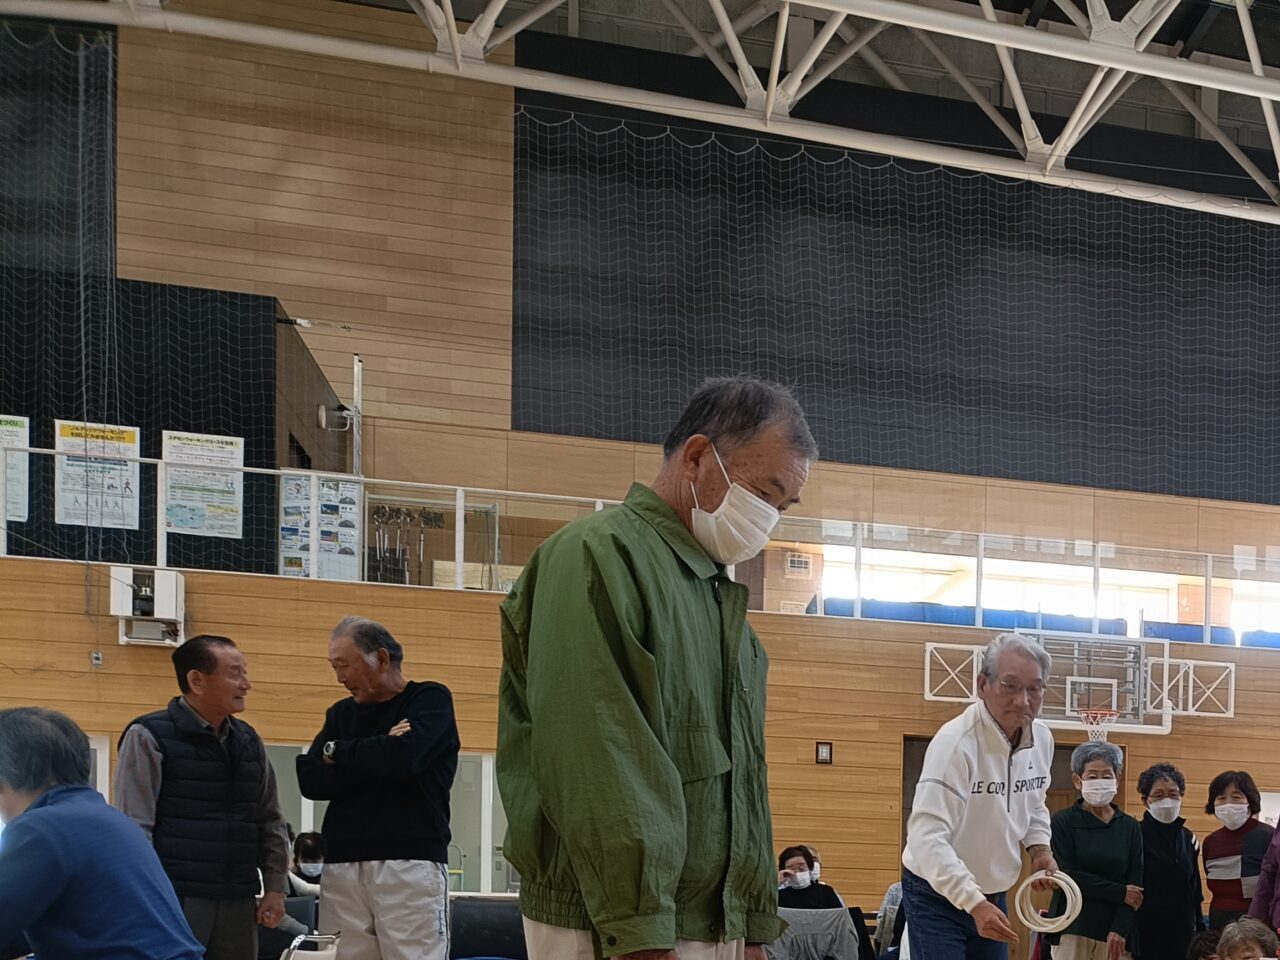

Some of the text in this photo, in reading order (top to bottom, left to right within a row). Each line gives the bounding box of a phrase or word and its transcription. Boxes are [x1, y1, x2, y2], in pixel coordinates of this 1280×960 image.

[972, 777, 1047, 796] LE COQ SPORTIF
